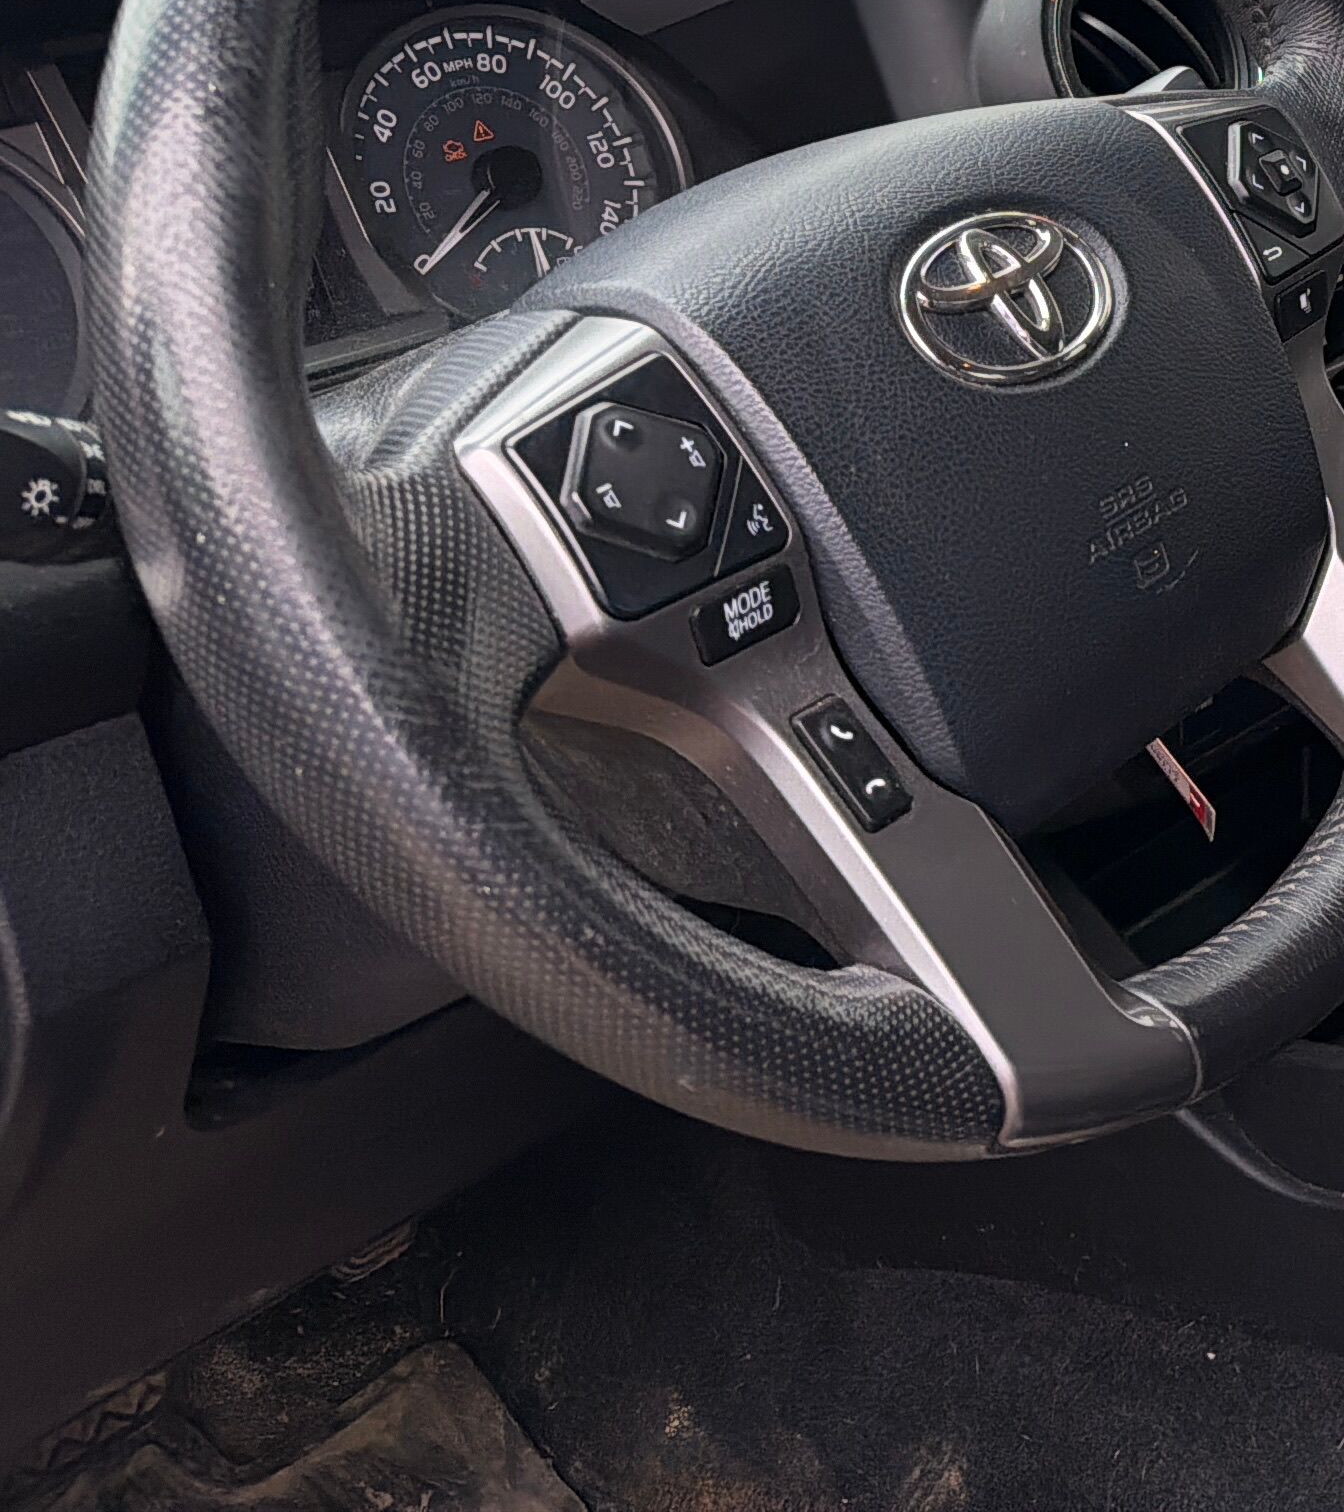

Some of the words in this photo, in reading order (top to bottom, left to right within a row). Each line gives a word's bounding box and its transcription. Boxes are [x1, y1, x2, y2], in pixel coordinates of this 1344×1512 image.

[411, 61, 442, 89] 60
[443, 58, 473, 73] MPH
[477, 53, 506, 74] 80
[538, 74, 576, 109] 100
[373, 109, 398, 143] 40
[586, 130, 615, 168] 120
[369, 181, 397, 213] 20
[1088, 487, 1188, 566] AIRBAG
[723, 580, 772, 623] MODE
[738, 603, 774, 635] HOLD
